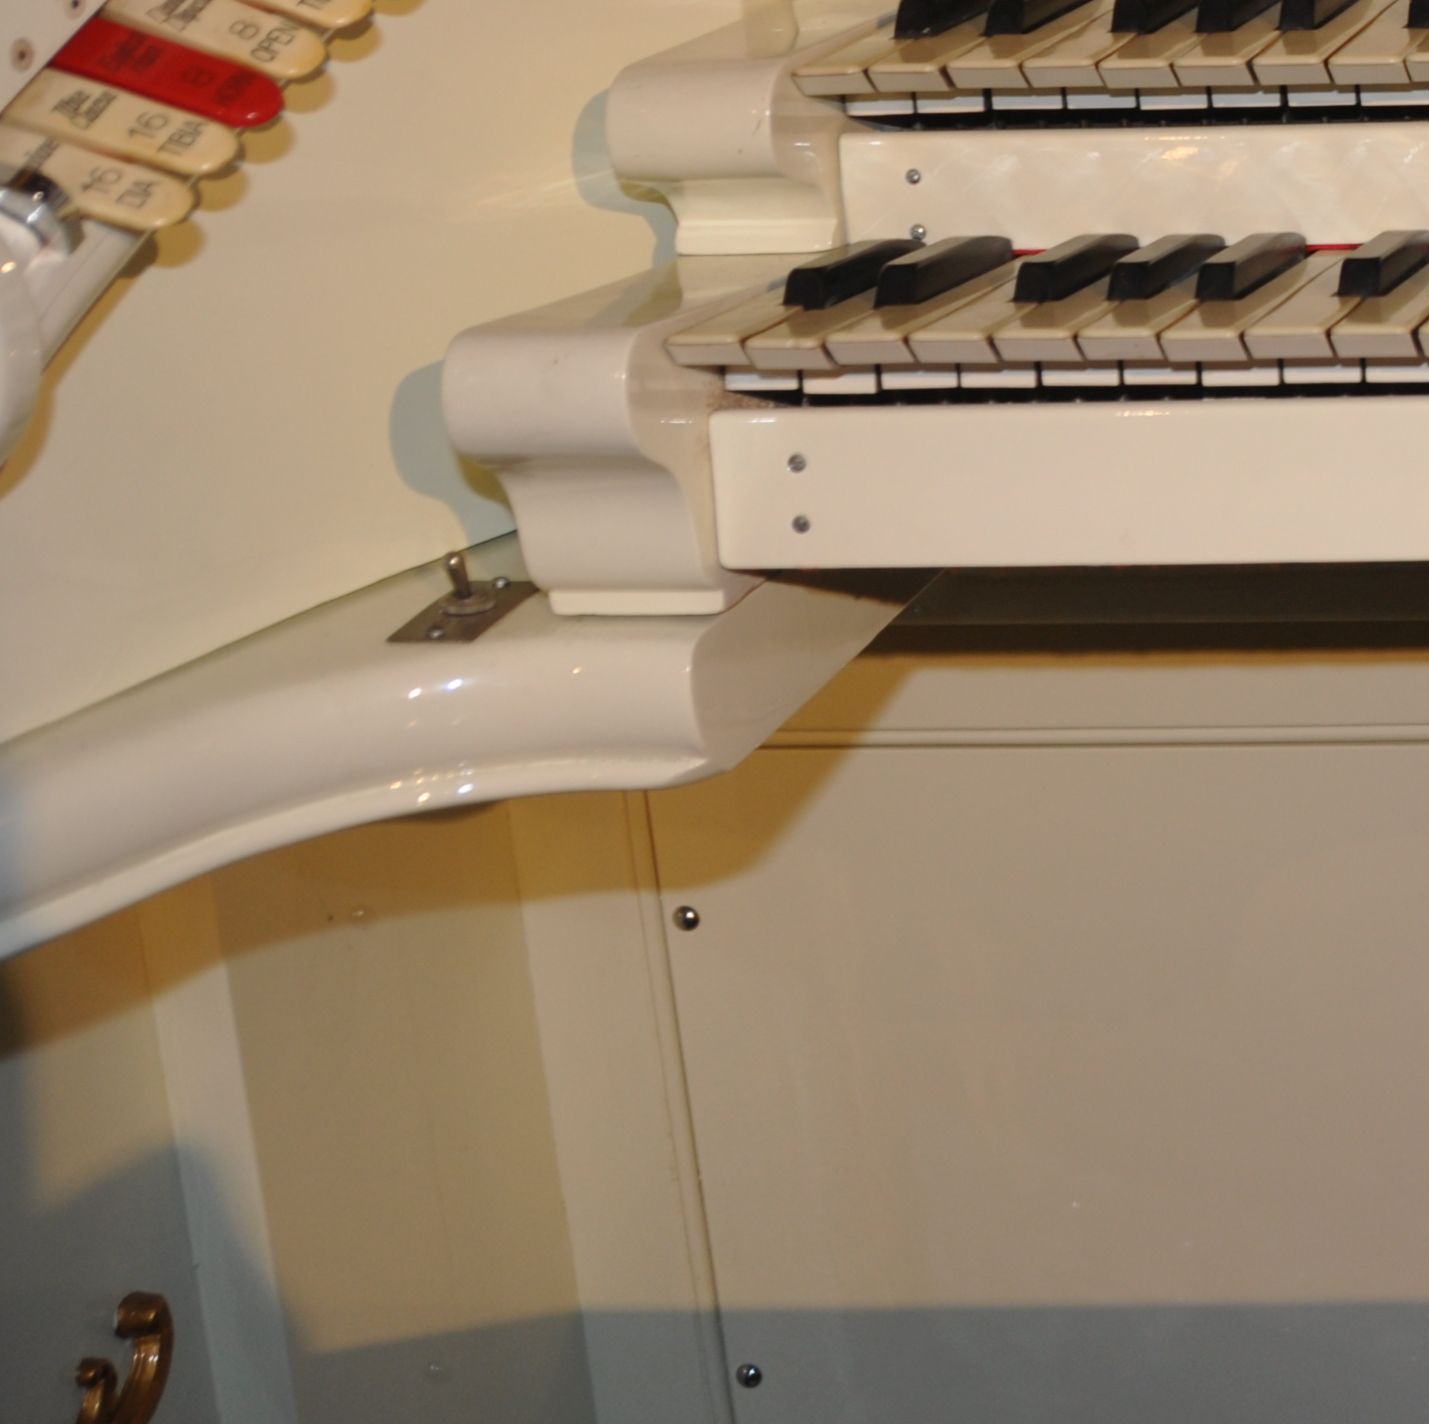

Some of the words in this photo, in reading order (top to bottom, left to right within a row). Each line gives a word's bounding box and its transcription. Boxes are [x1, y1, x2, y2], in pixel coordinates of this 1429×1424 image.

[229, 20, 260, 40] 8
[250, 20, 300, 62] OPEN
[156, 120, 210, 156] TIBIA
